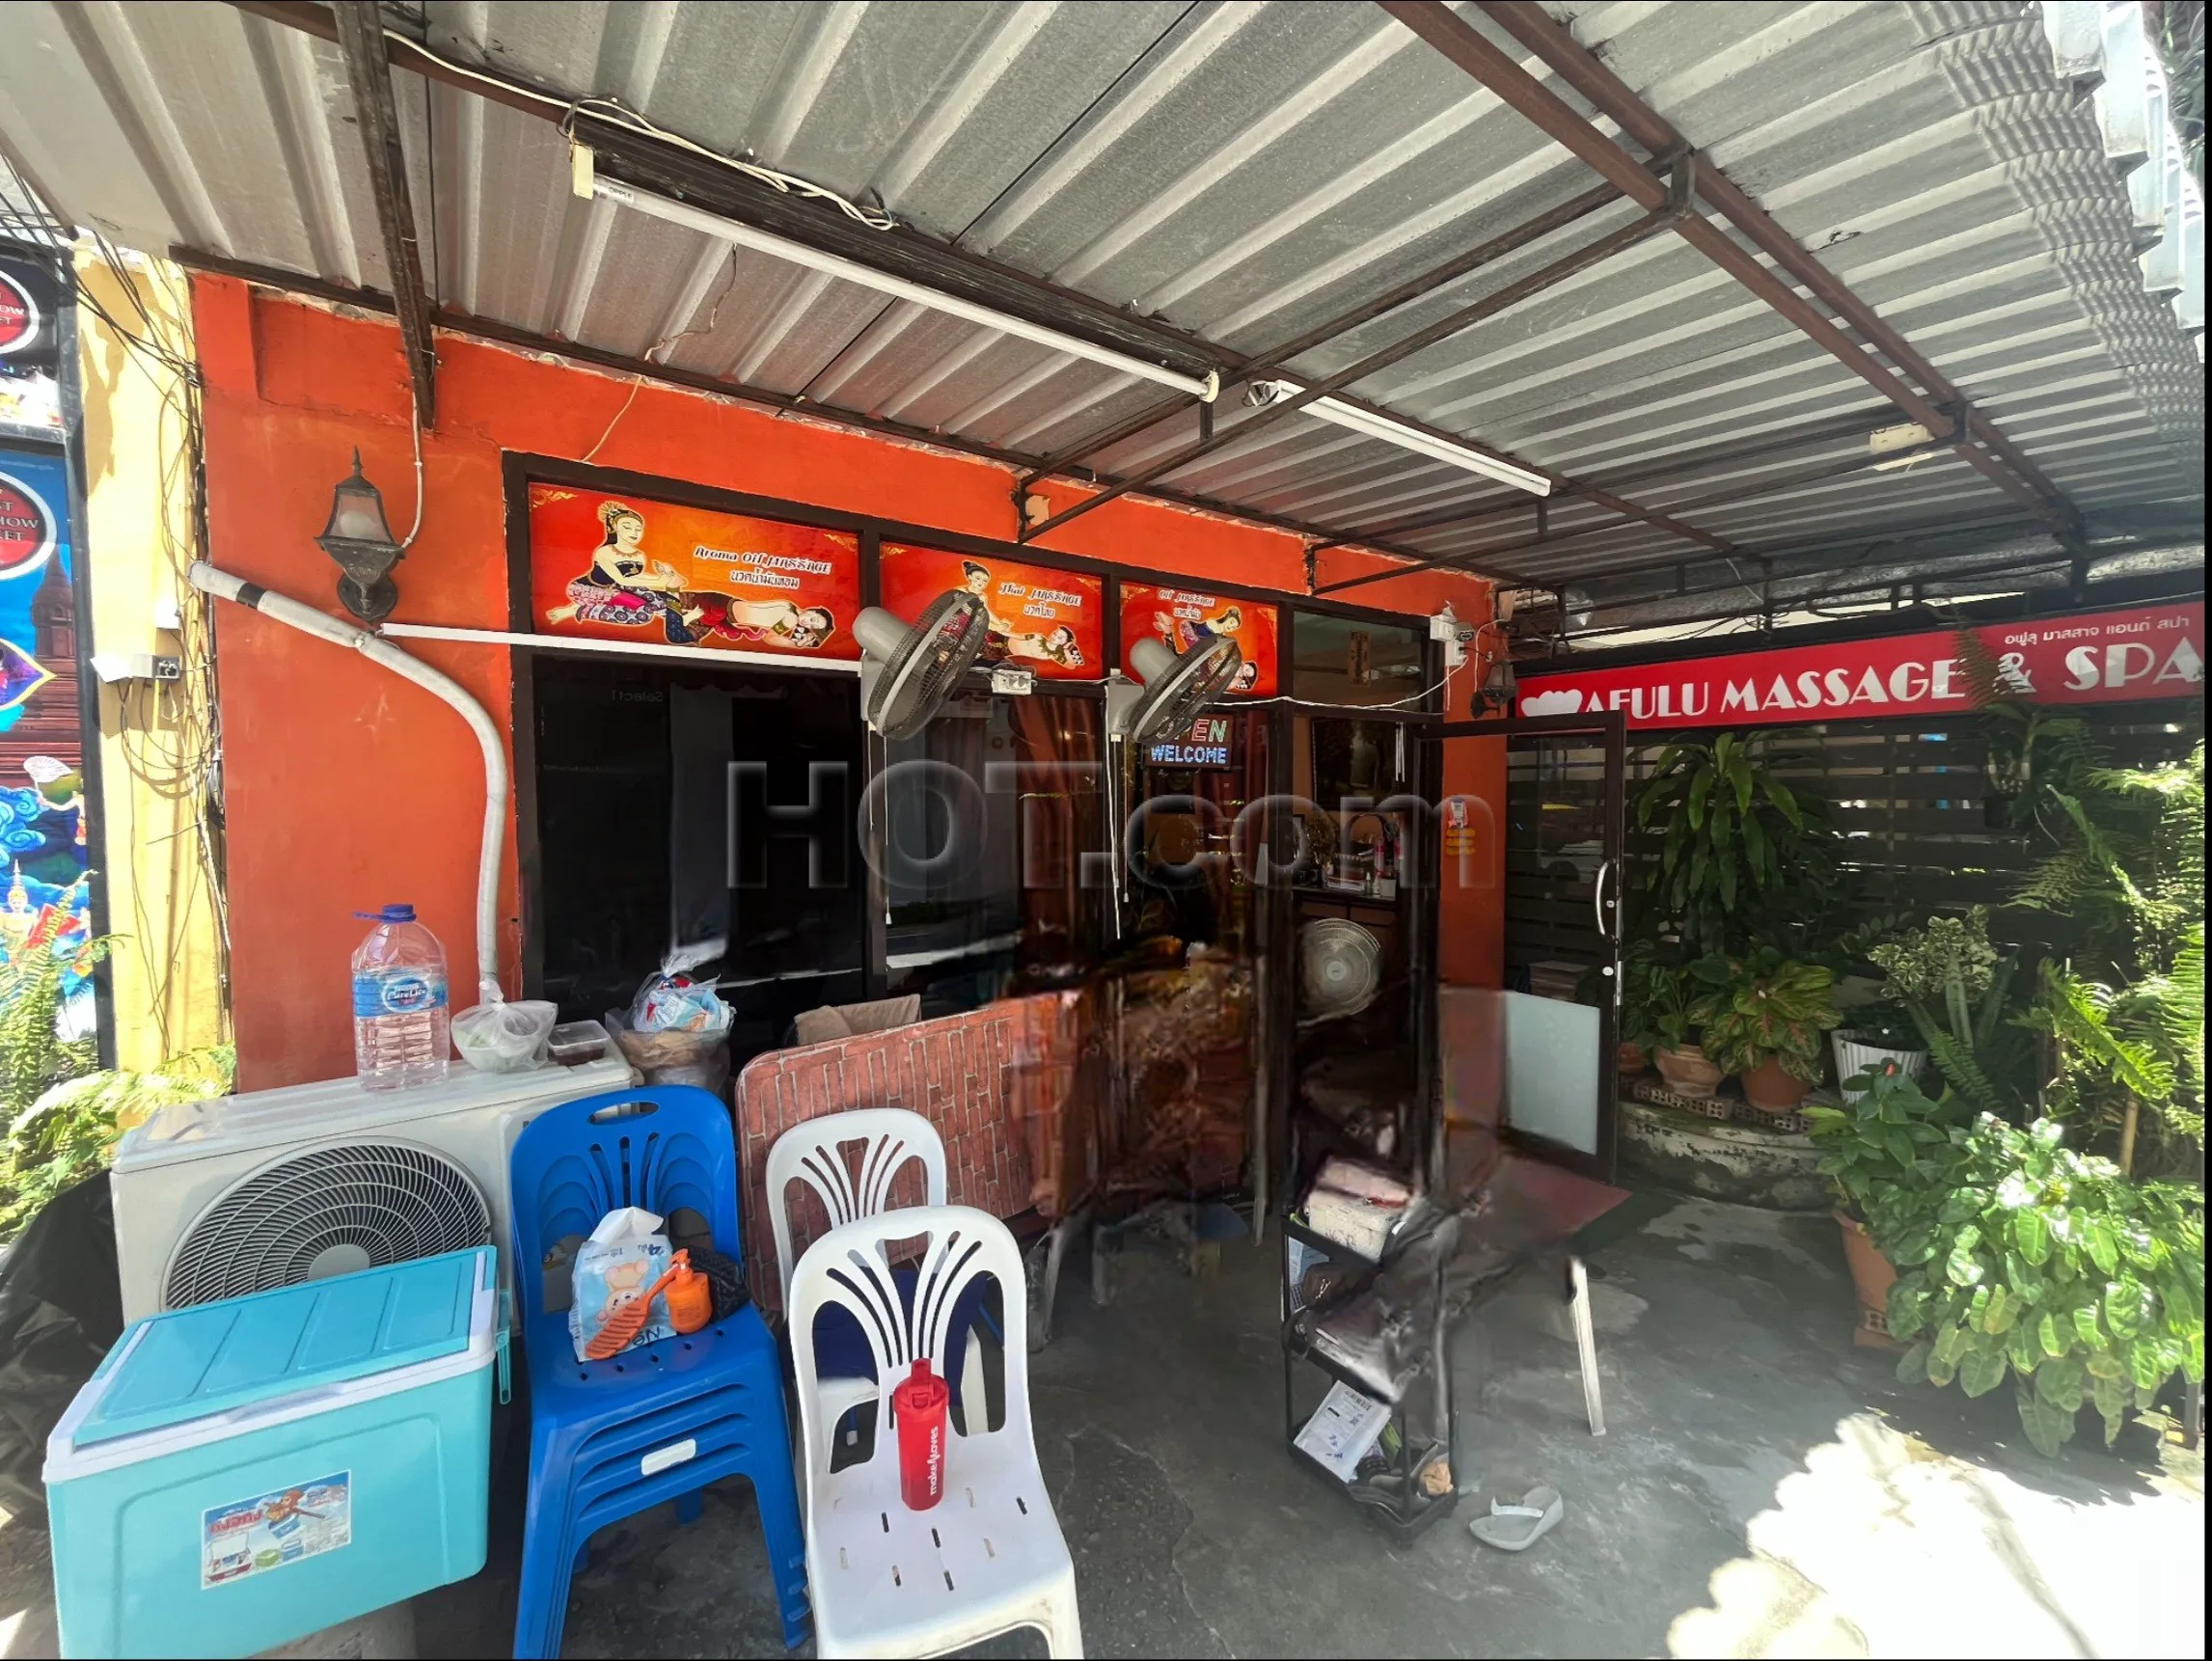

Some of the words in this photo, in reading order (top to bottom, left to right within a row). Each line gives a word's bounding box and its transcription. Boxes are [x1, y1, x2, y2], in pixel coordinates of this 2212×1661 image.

[695, 546, 738, 560] Aroma
[2157, 615, 2189, 630] สปา
[1585, 682, 1708, 719] AFULU
[1720, 658, 1967, 713] MASSAGE
[1992, 652, 2036, 694] &
[2063, 637, 2204, 690] SPA
[1151, 744, 1227, 764] WELCOME
